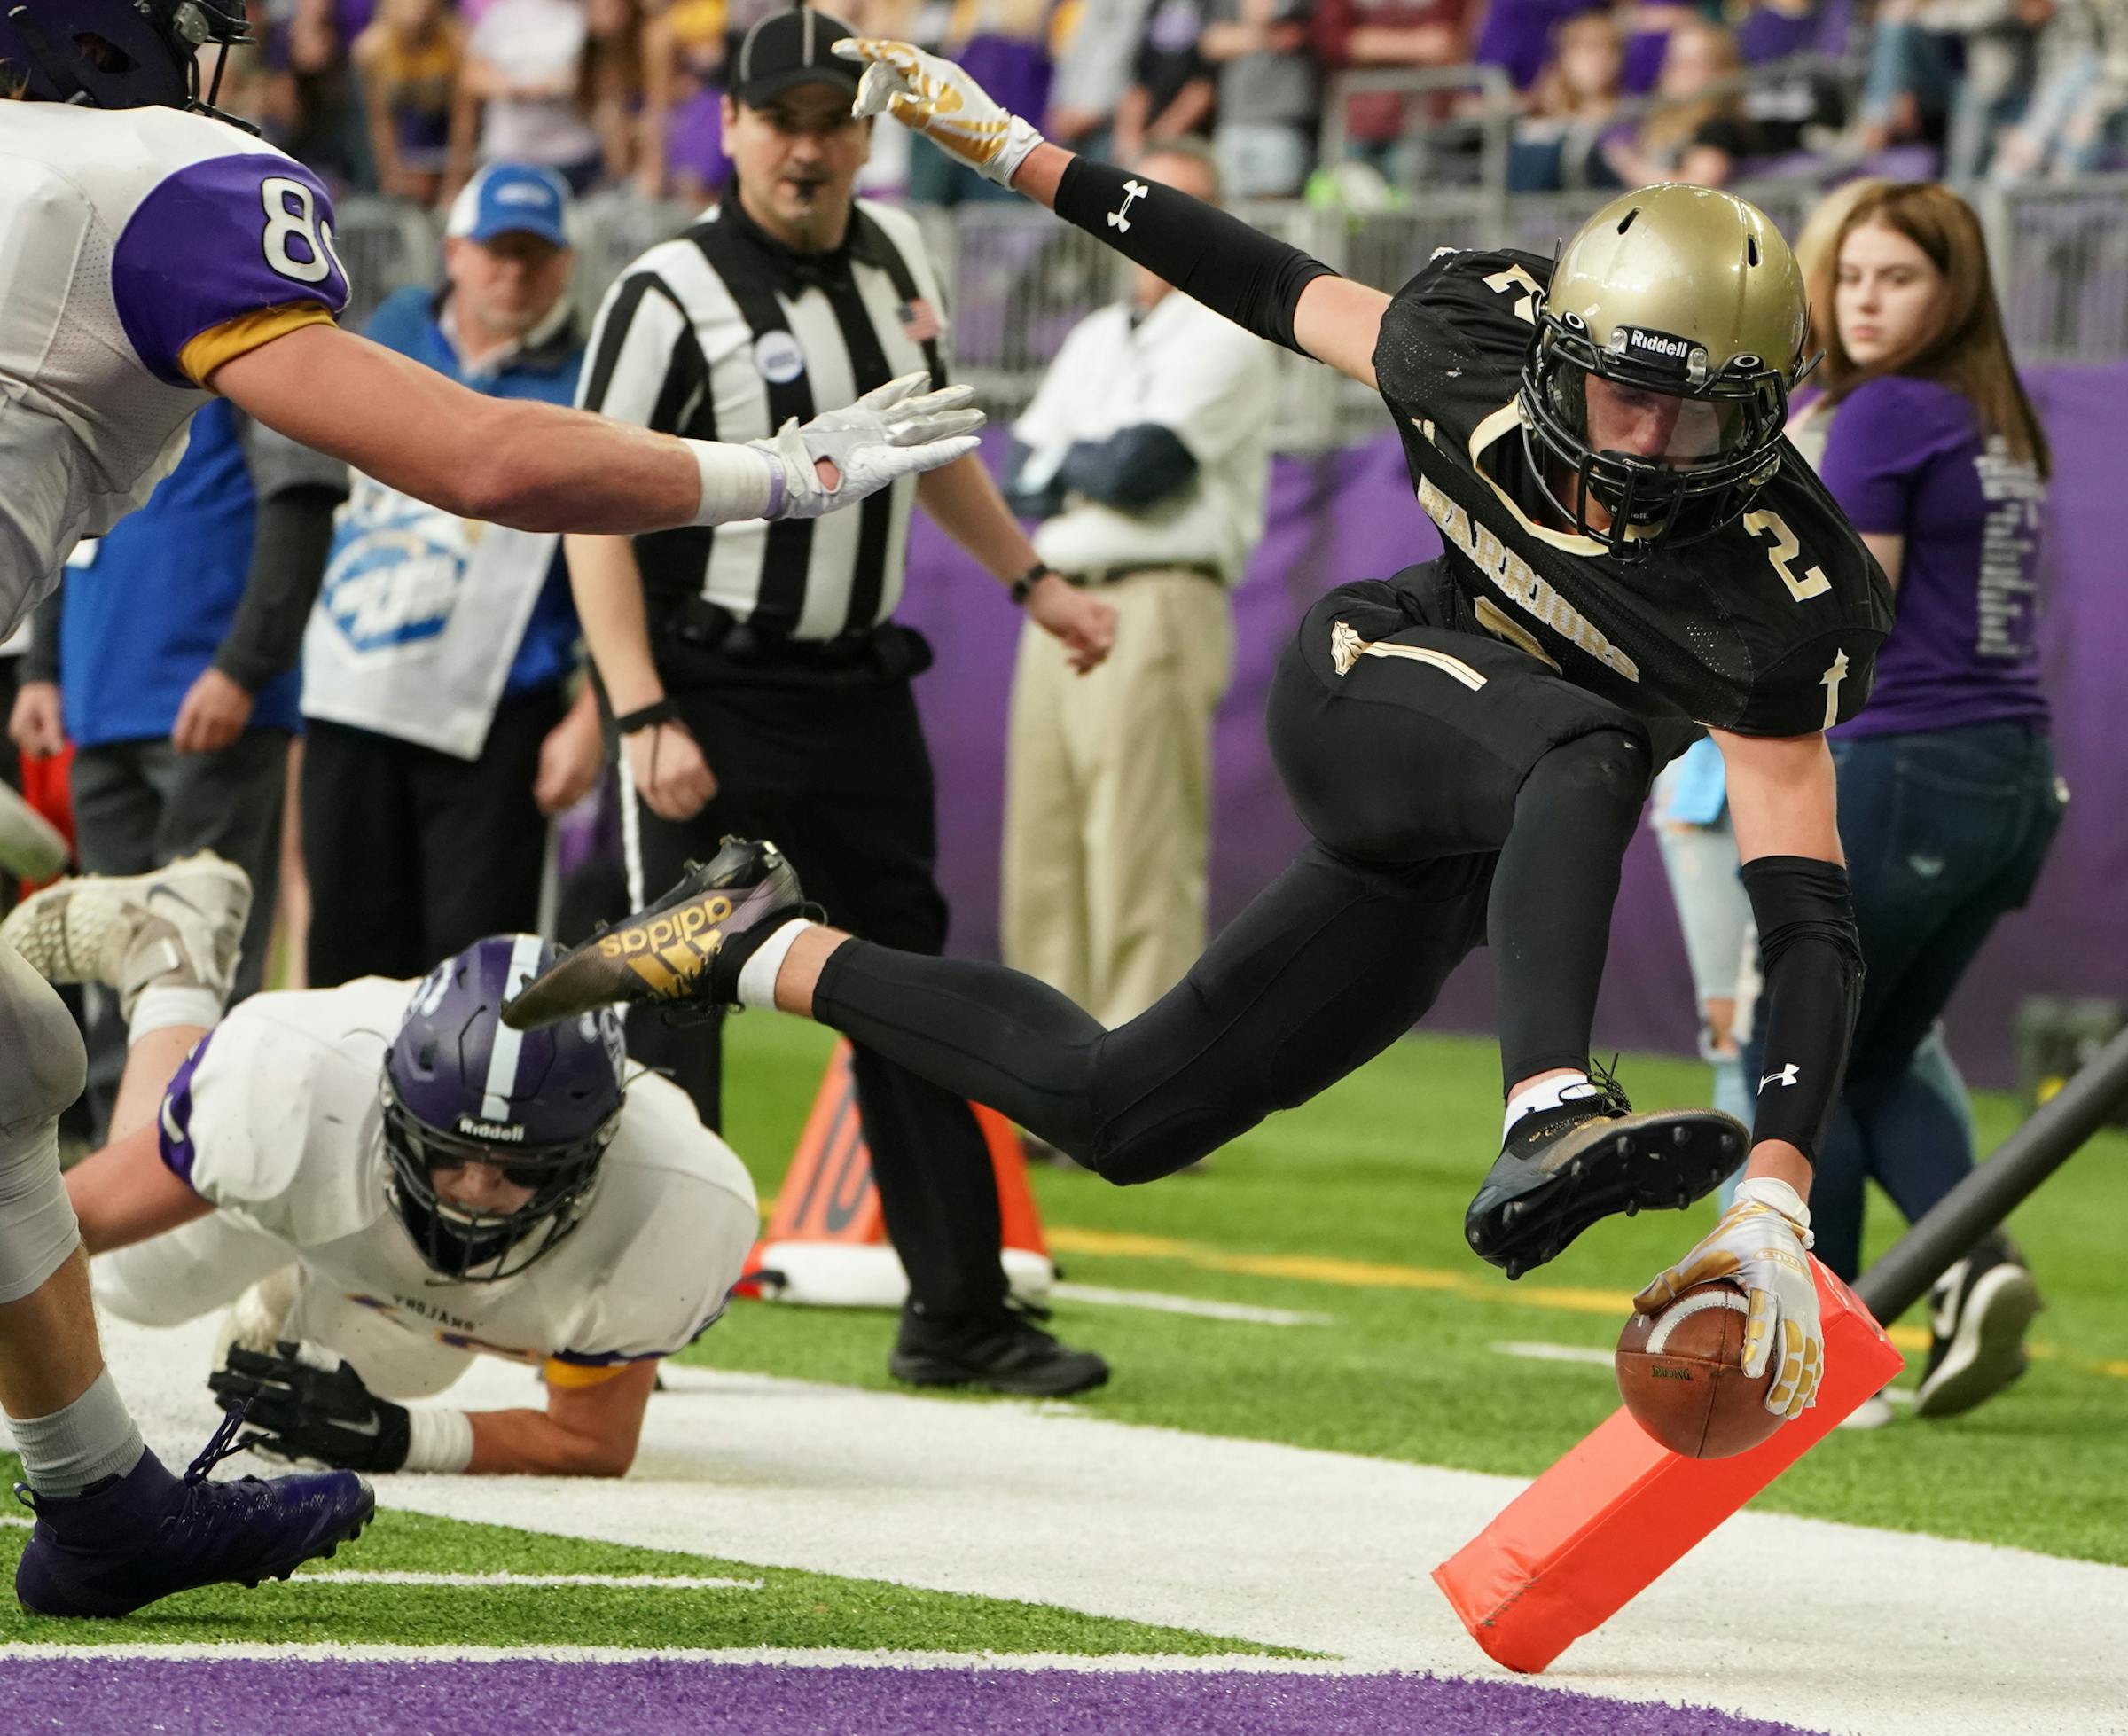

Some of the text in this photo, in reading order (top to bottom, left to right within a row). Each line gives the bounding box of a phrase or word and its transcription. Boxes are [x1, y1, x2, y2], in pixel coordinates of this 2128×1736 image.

[262, 177, 352, 314] 8
[1631, 329, 1688, 358] Riddell
[1743, 509, 1832, 602] 2
[598, 895, 732, 958] adidas
[460, 1119, 525, 1142] Riddell
